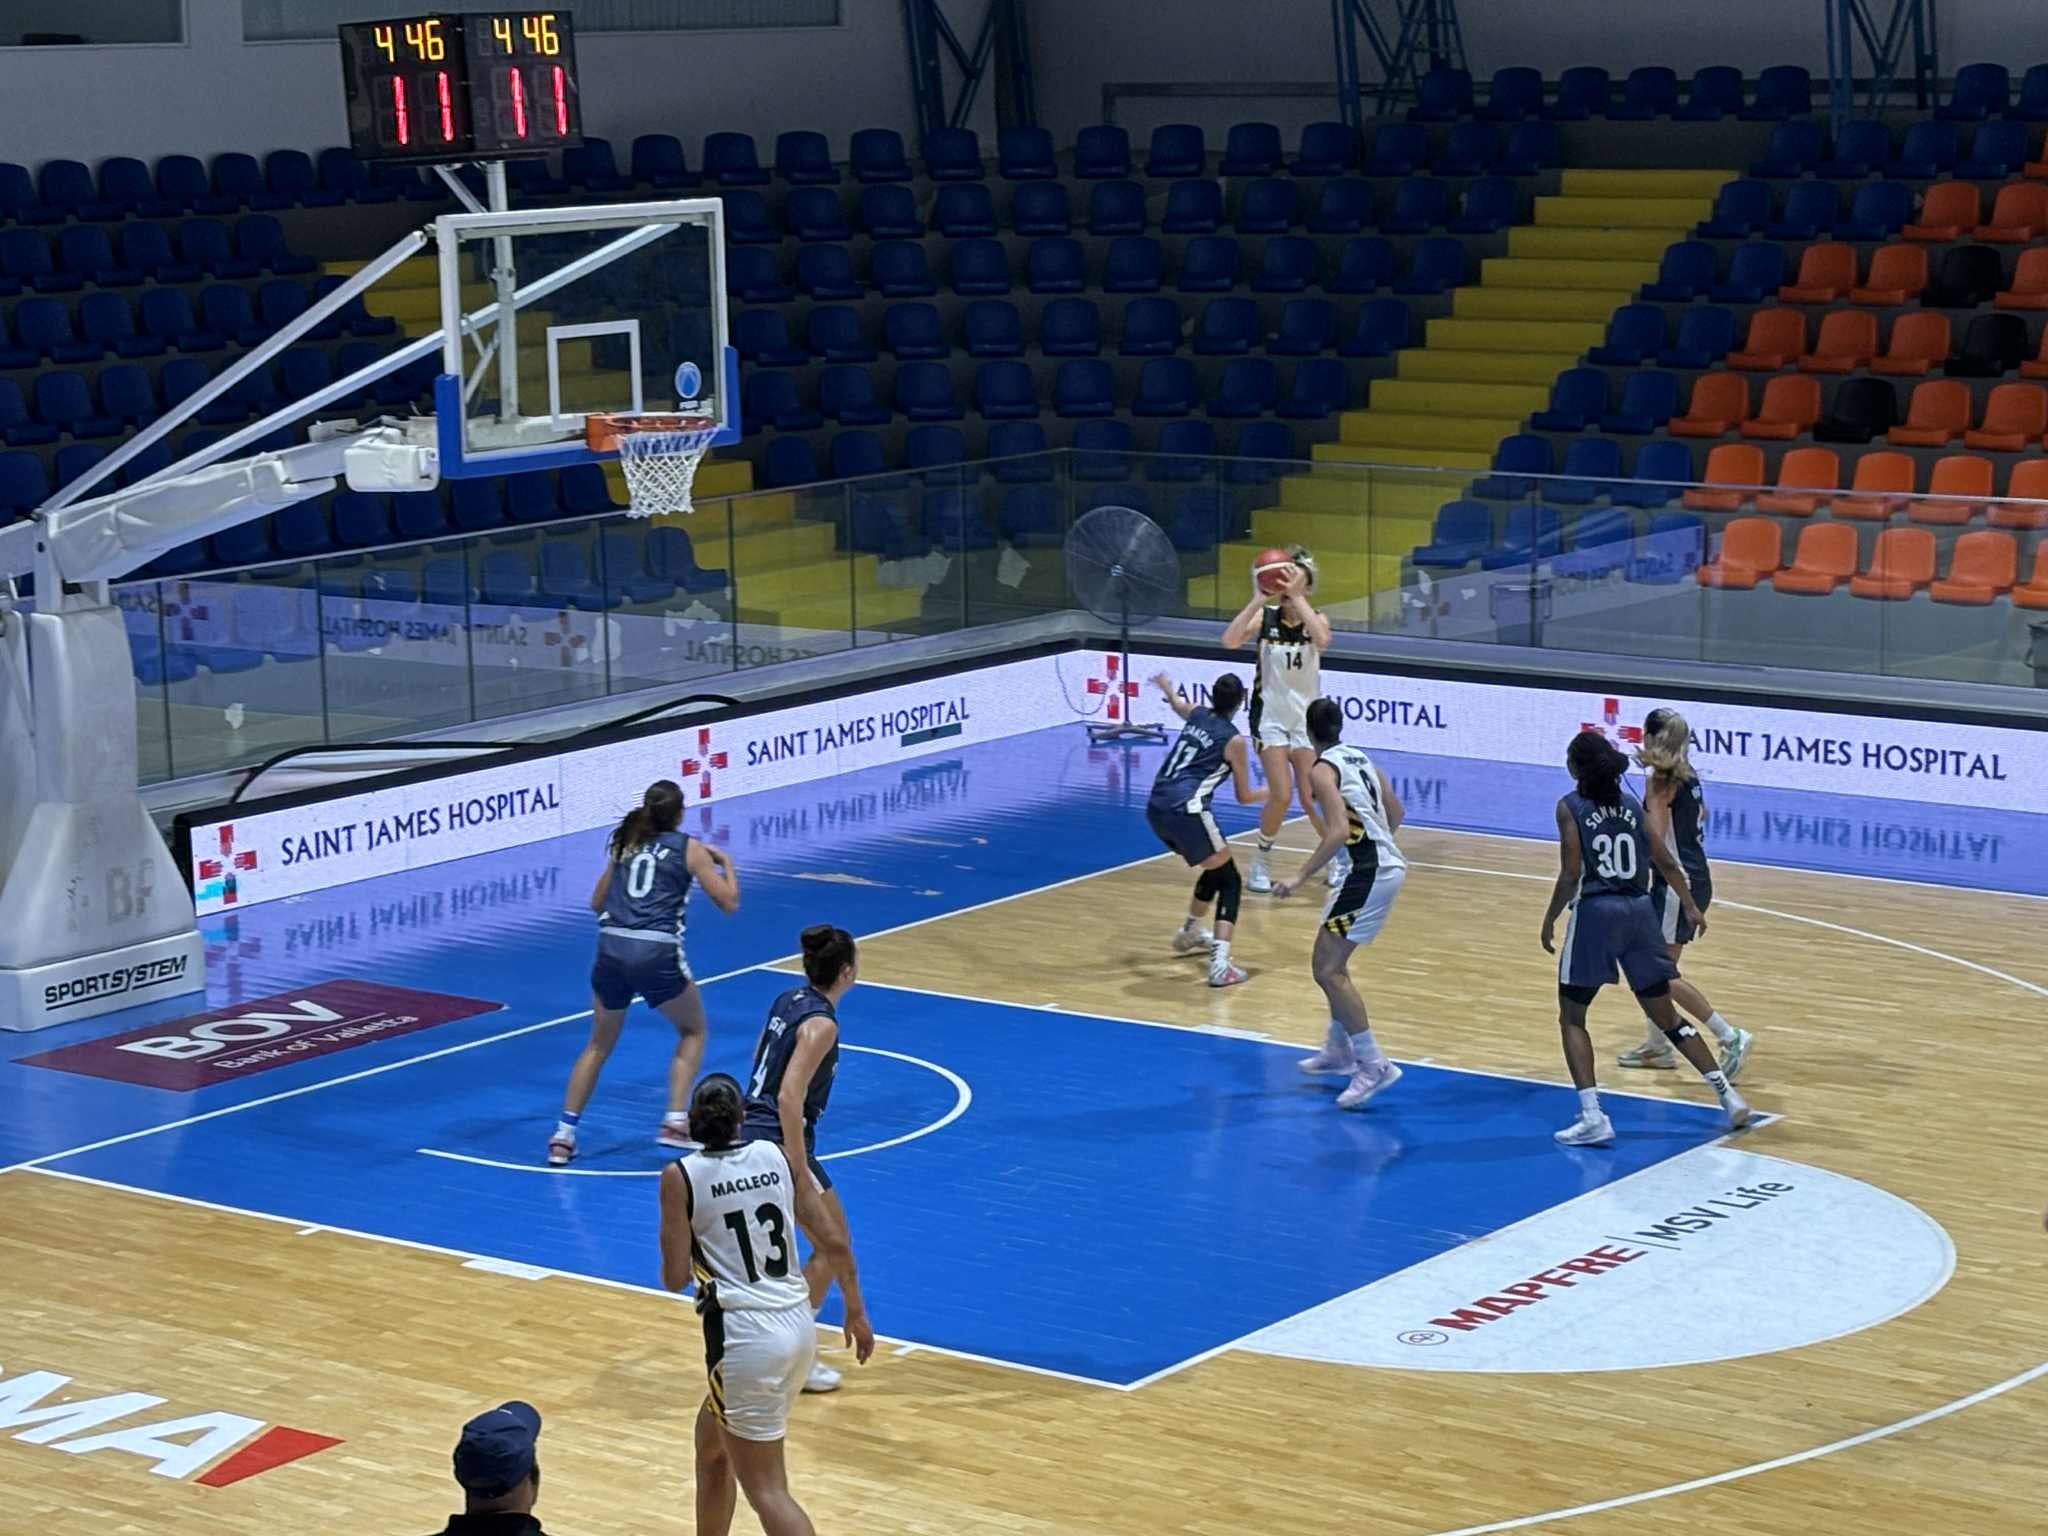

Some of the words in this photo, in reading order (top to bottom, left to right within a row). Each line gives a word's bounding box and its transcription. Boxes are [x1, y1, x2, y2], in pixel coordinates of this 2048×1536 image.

[374, 26, 395, 63] 4
[404, 20, 445, 60] 46
[493, 18, 513, 54] 4
[522, 15, 560, 55] 46
[392, 71, 455, 145] 11
[510, 65, 568, 138] 11
[1285, 651, 1303, 671] 14
[747, 730, 809, 766] SAINT
[814, 716, 876, 755] JAMES
[881, 696, 971, 738] HOSPITAL
[1326, 694, 1448, 730] OSPITAL
[1688, 727, 1753, 758] AINT
[1761, 733, 1852, 767] JAMES
[1862, 742, 2008, 782] HOSPITAL
[282, 823, 357, 866] SAINT
[365, 807, 441, 851] JAMES
[448, 783, 560, 831] HOSPITAL
[627, 852, 657, 898] 0
[1591, 832, 1637, 880] 30
[44, 953, 188, 1006] SPORTSYSTEM
[114, 999, 345, 1060] BOV
[212, 1046, 285, 1069] Bank
[285, 1038, 318, 1051] of
[313, 1015, 420, 1043] Valletta
[711, 1171, 780, 1199] MACLEOD
[723, 1202, 789, 1284] 13
[1427, 1244, 1649, 1332] MAPFRE
[1634, 1206, 1731, 1242] MSV
[1707, 1182, 1796, 1209] Life
